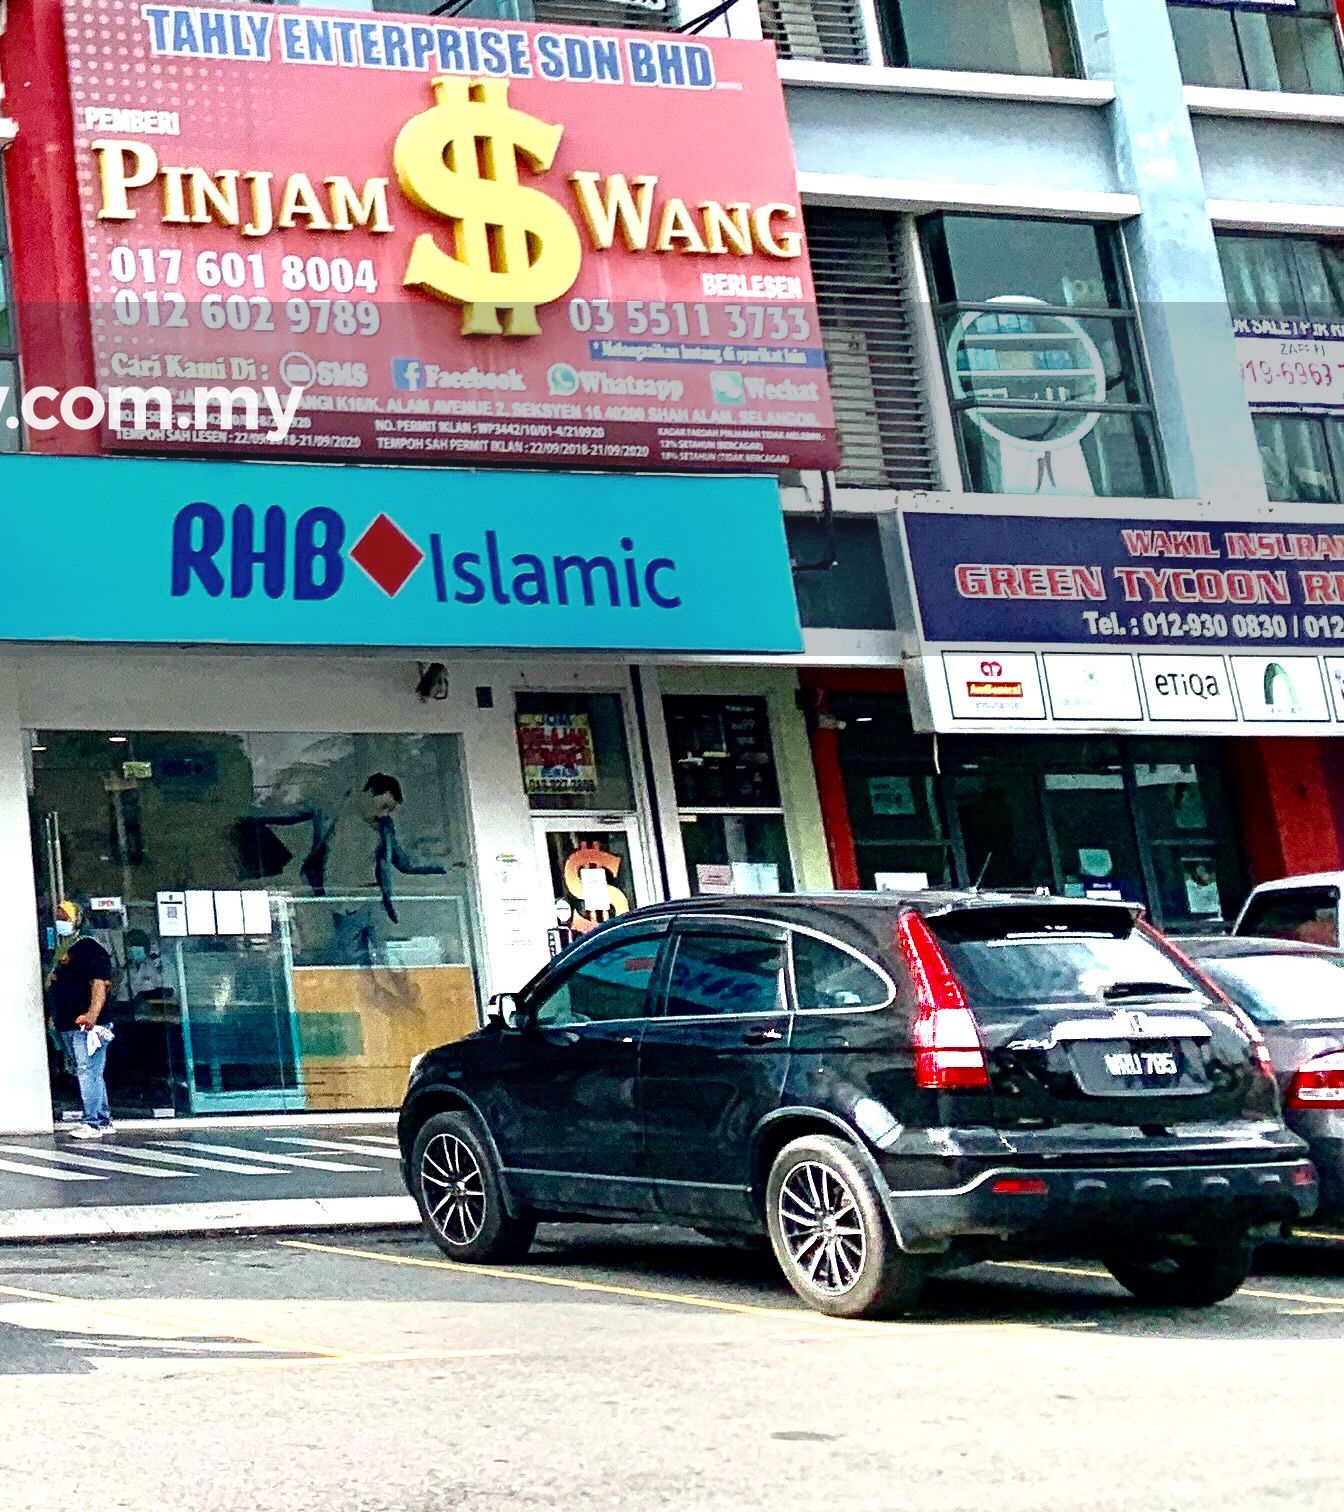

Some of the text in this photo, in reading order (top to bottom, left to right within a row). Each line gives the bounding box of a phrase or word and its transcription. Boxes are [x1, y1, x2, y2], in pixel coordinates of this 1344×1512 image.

[145, 8, 713, 87] TAHLY ENTERPRISE SDN BHD
[83, 108, 180, 135] PEMBERI
[91, 139, 802, 258] PINJAM WANG
[111, 247, 378, 293] 017 601 8004
[701, 273, 803, 298] BERLESEN
[114, 290, 379, 336] 012 602 9789
[569, 298, 810, 340] 03 5511 3733
[111, 352, 819, 401] Cari Kami Di SMS Facebook Whatsapp Wechat
[171, 502, 683, 608] RHB Islamic
[1121, 529, 1219, 559] WAKIL
[955, 563, 1291, 605] GREEN TYCOON
[1143, 613, 1227, 638] 012-930
[1232, 614, 1287, 638] 0830
